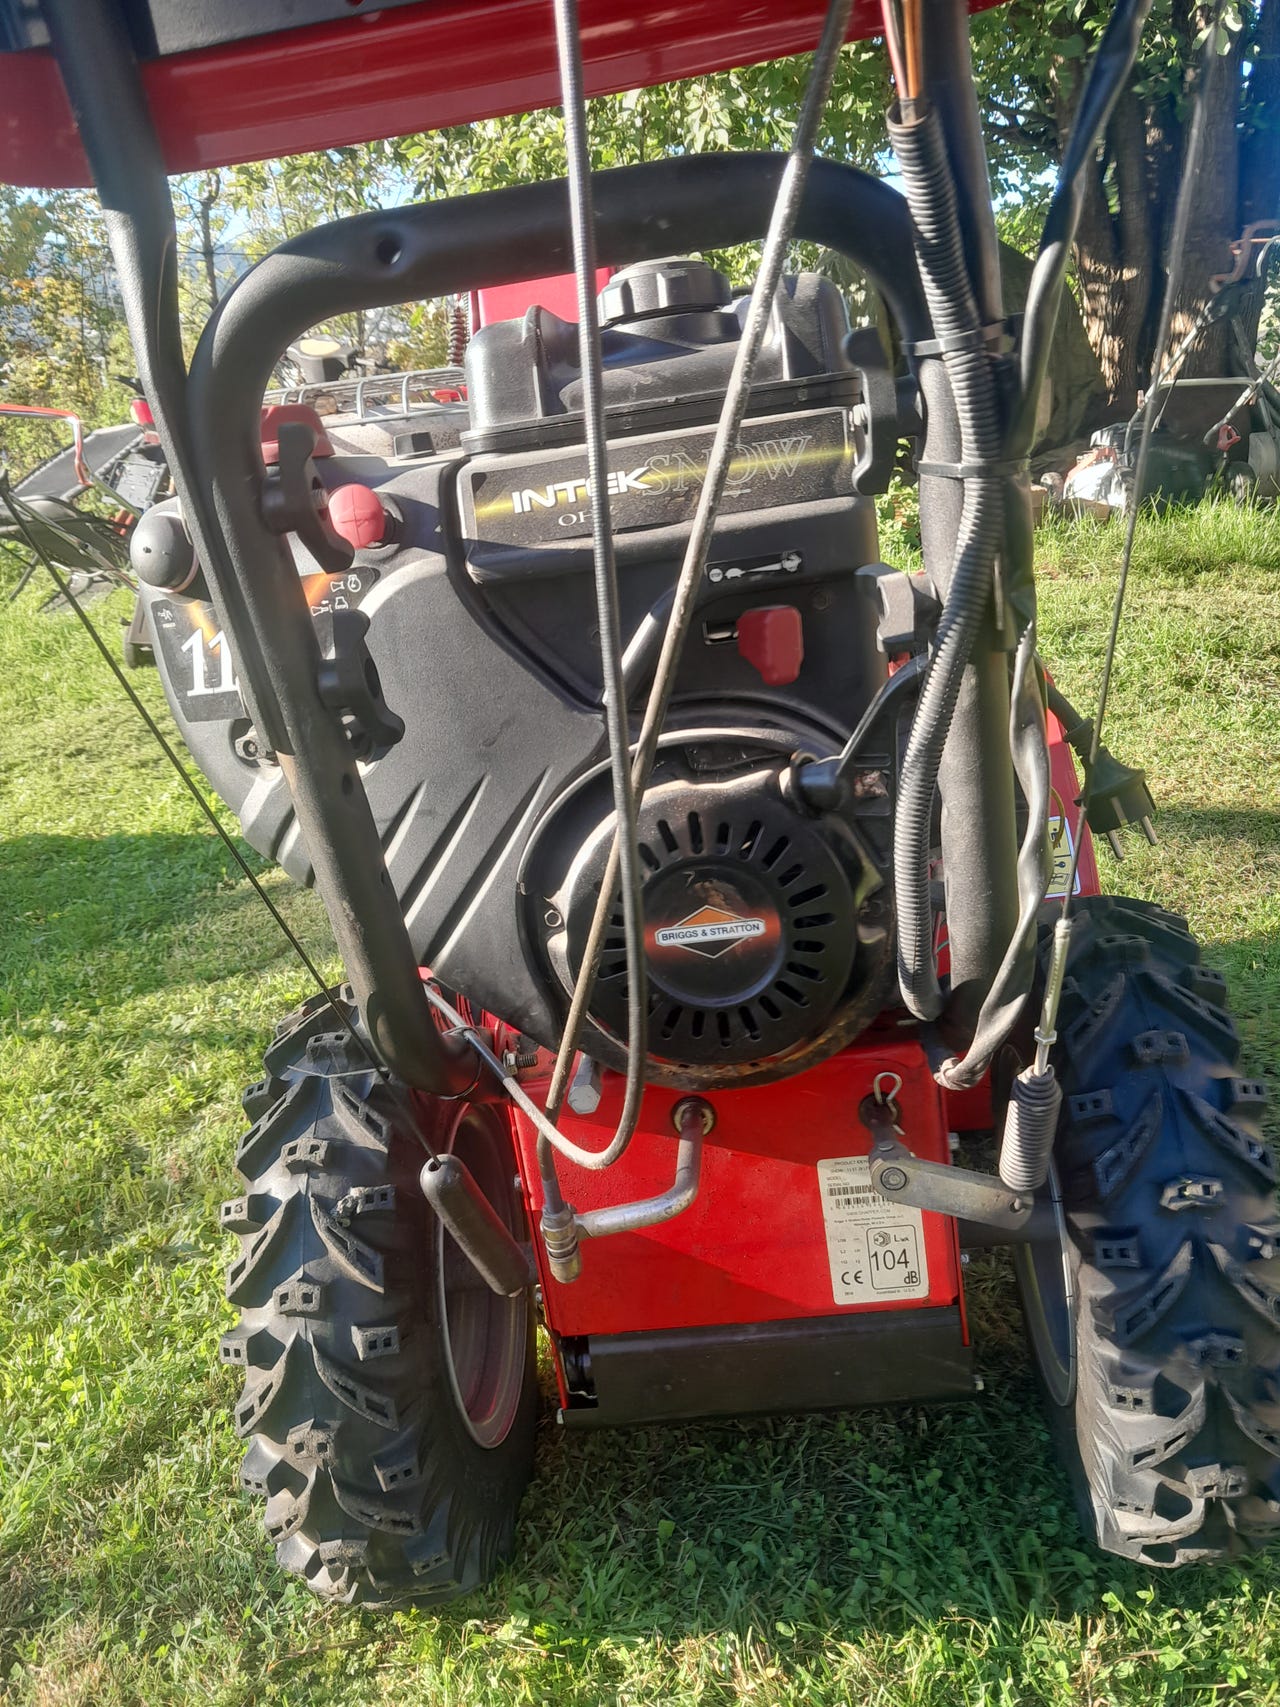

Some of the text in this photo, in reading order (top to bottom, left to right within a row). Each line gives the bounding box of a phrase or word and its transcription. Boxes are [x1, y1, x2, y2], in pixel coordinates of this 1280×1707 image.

[181, 628, 240, 697] 11
[661, 923, 760, 941] BRIGGS & STRATTON
[870, 1248, 910, 1271] 104
[903, 1270, 919, 1285] dB
